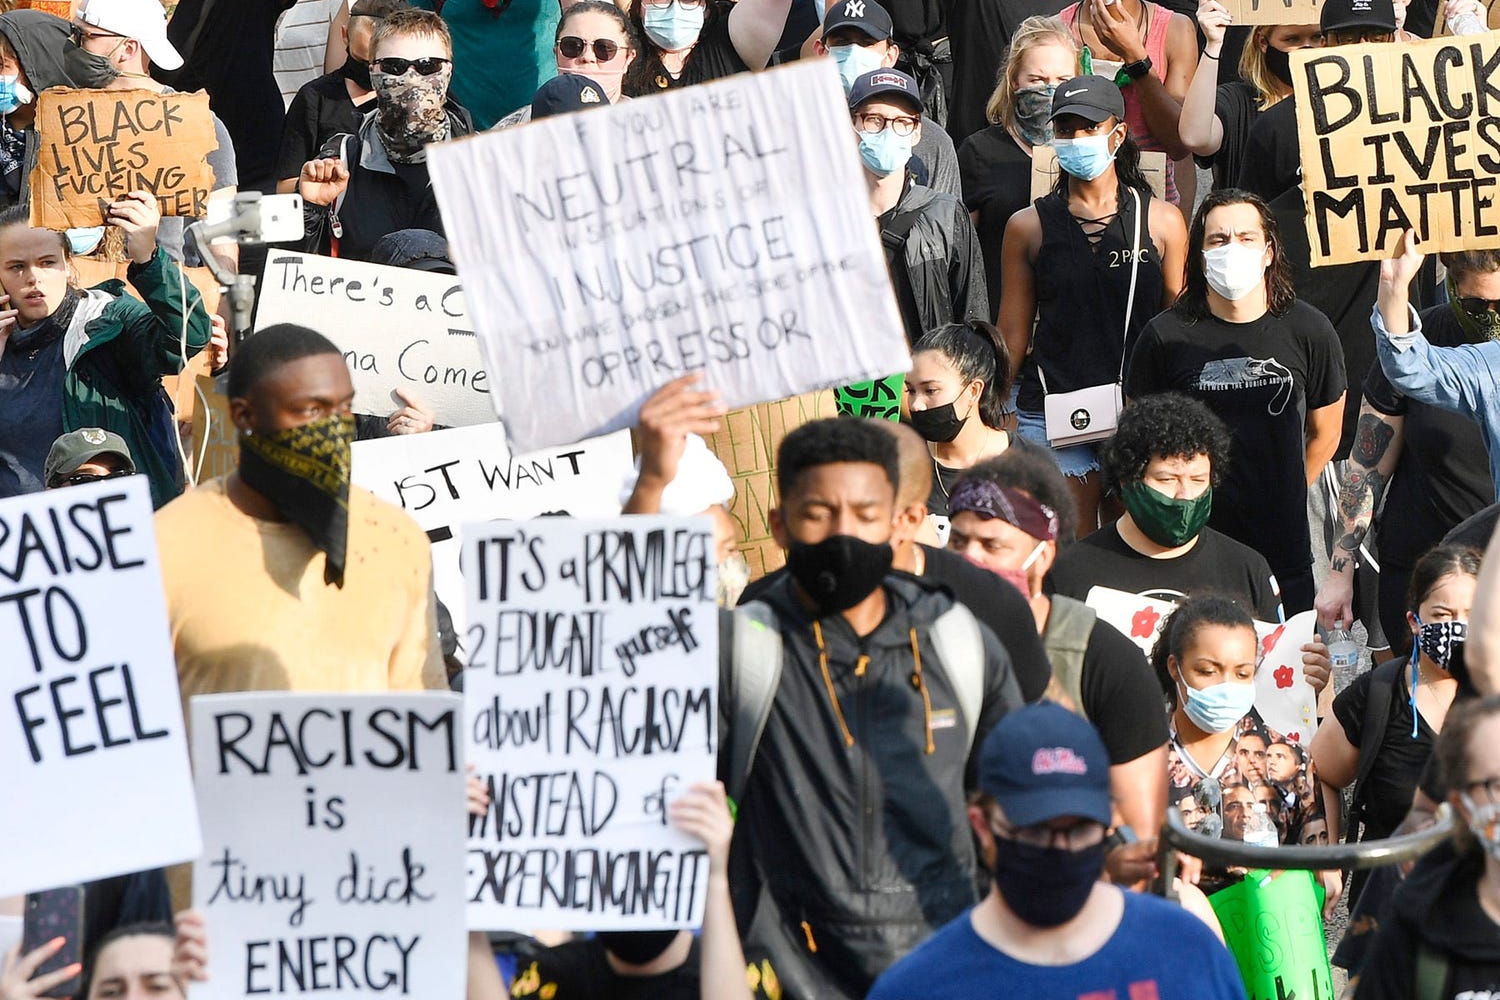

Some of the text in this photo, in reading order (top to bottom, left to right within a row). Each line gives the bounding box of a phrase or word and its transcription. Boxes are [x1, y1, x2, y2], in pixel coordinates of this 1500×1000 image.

[58, 99, 183, 147] BLACK
[51, 141, 149, 175] LIVES
[53, 166, 186, 201] FUCKING
[515, 125, 788, 233] NEUTRAL
[272, 256, 394, 306] There's
[553, 216, 795, 310] INJUSTICE
[398, 339, 491, 394] Come
[581, 310, 812, 389] OPPRESSOR
[478, 450, 586, 493] WANT
[477, 529, 546, 602] IT'S
[0, 584, 89, 674] TO
[14, 662, 170, 764] FEEL
[215, 707, 458, 775] RACISM
[473, 685, 715, 757] about RACISM
[304, 786, 346, 830] is
[469, 770, 619, 841] INSTEAD
[207, 846, 438, 926] tiny dick
[245, 934, 420, 995] ENERGY
